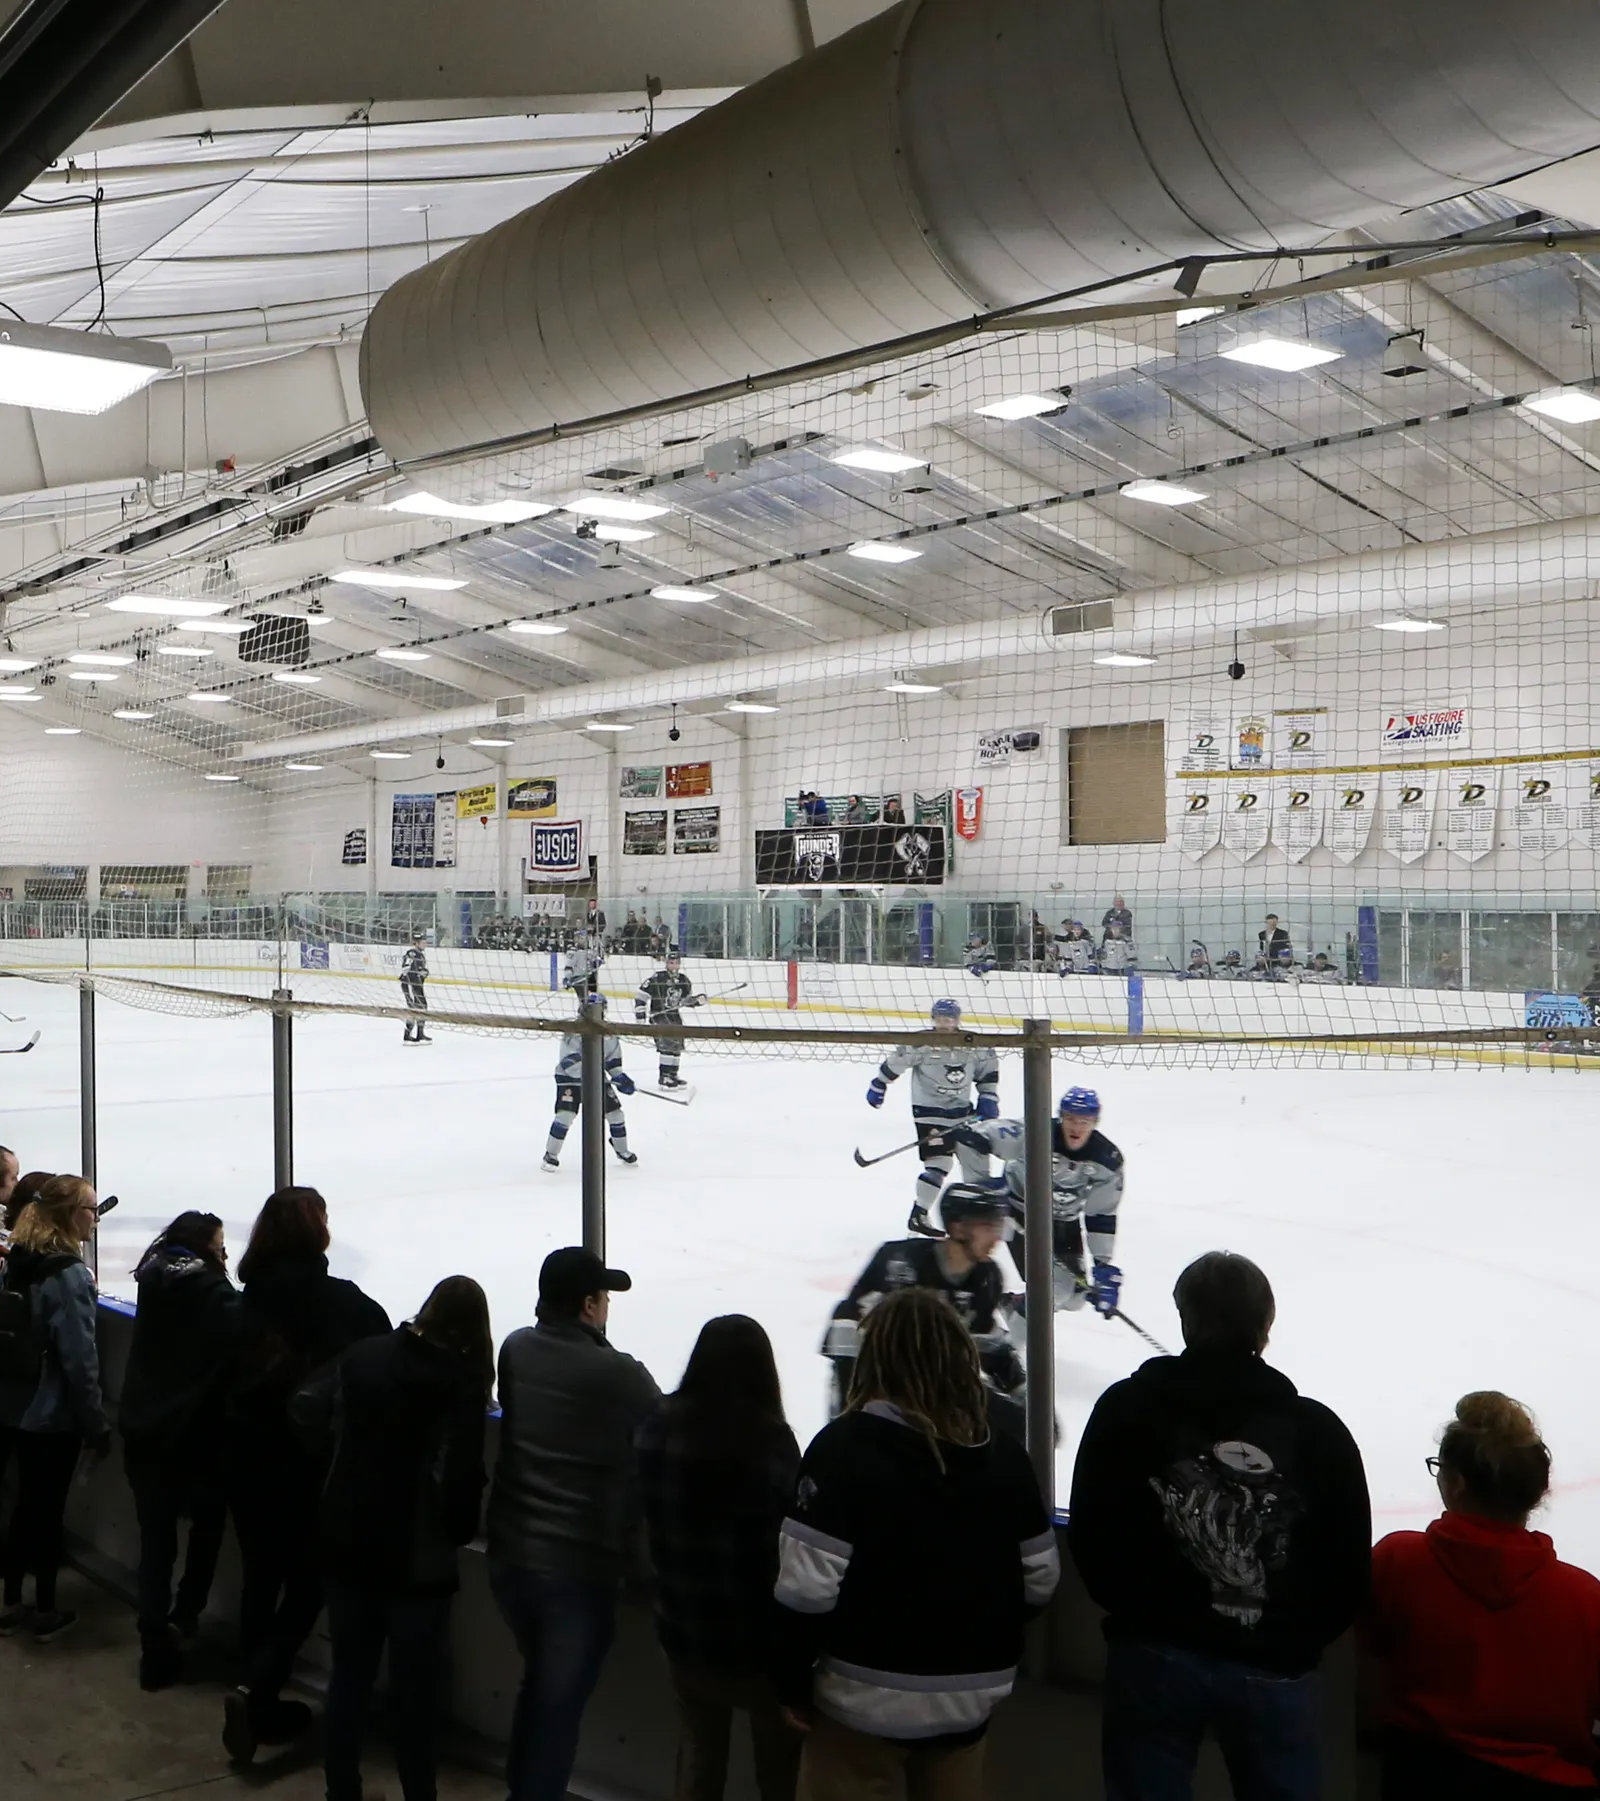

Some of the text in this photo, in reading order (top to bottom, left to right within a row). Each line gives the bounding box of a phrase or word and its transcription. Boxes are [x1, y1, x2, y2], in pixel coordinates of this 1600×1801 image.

[1412, 721, 1463, 738] SKATING
[542, 832, 570, 861] USO
[794, 833, 840, 859] THUNDER
